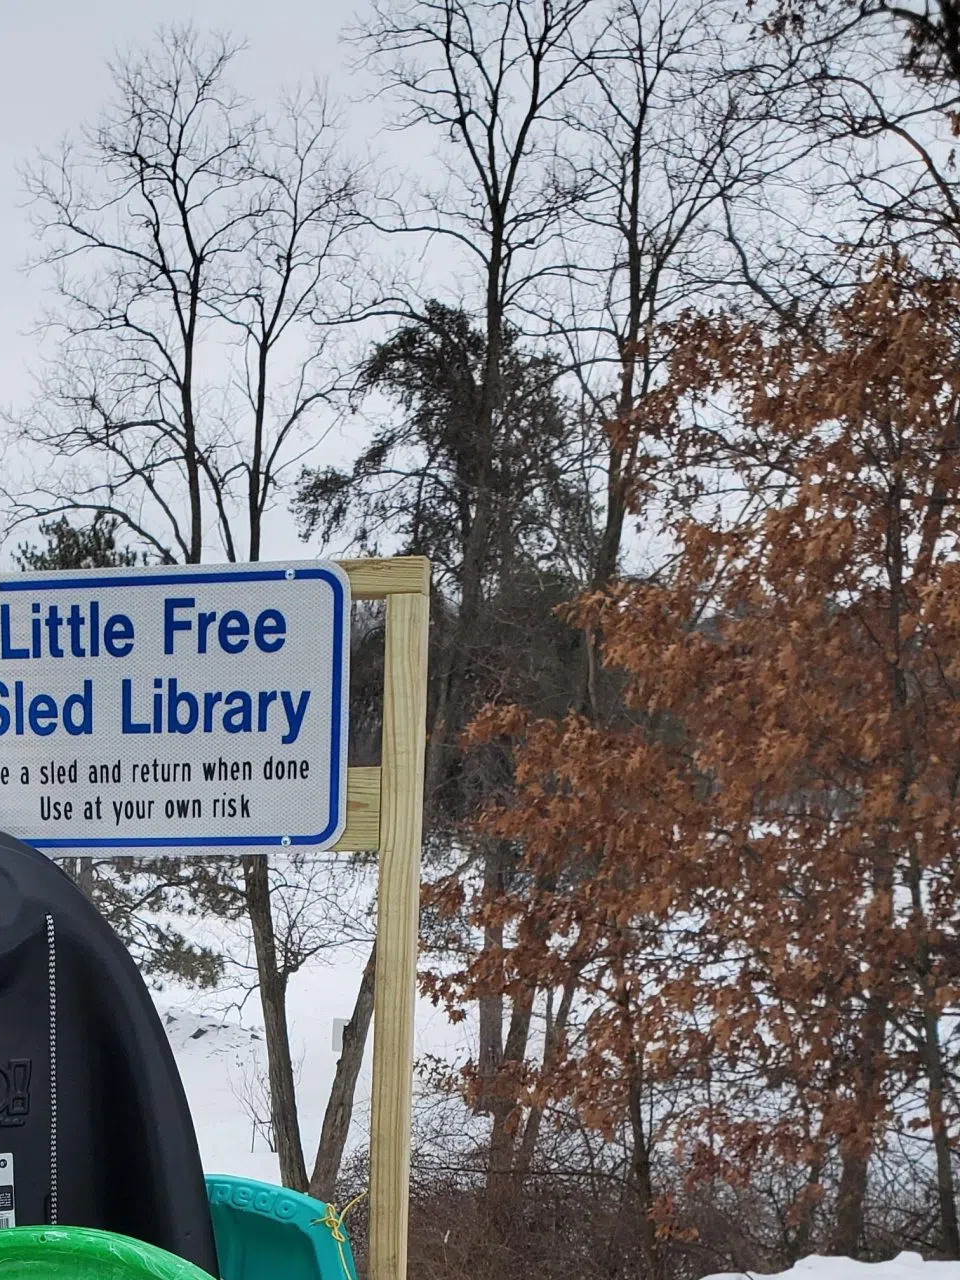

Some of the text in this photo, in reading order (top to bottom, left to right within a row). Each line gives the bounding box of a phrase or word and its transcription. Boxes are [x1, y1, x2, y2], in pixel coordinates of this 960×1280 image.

[0, 598, 287, 659] Little Free
[122, 678, 311, 744] Library
[20, 767, 30, 785] a
[40, 760, 78, 784] sled
[89, 760, 121, 784] and
[133, 759, 191, 783] return
[203, 757, 252, 781] when
[264, 756, 310, 780] done
[41, 793, 251, 826] Use at your own risk
